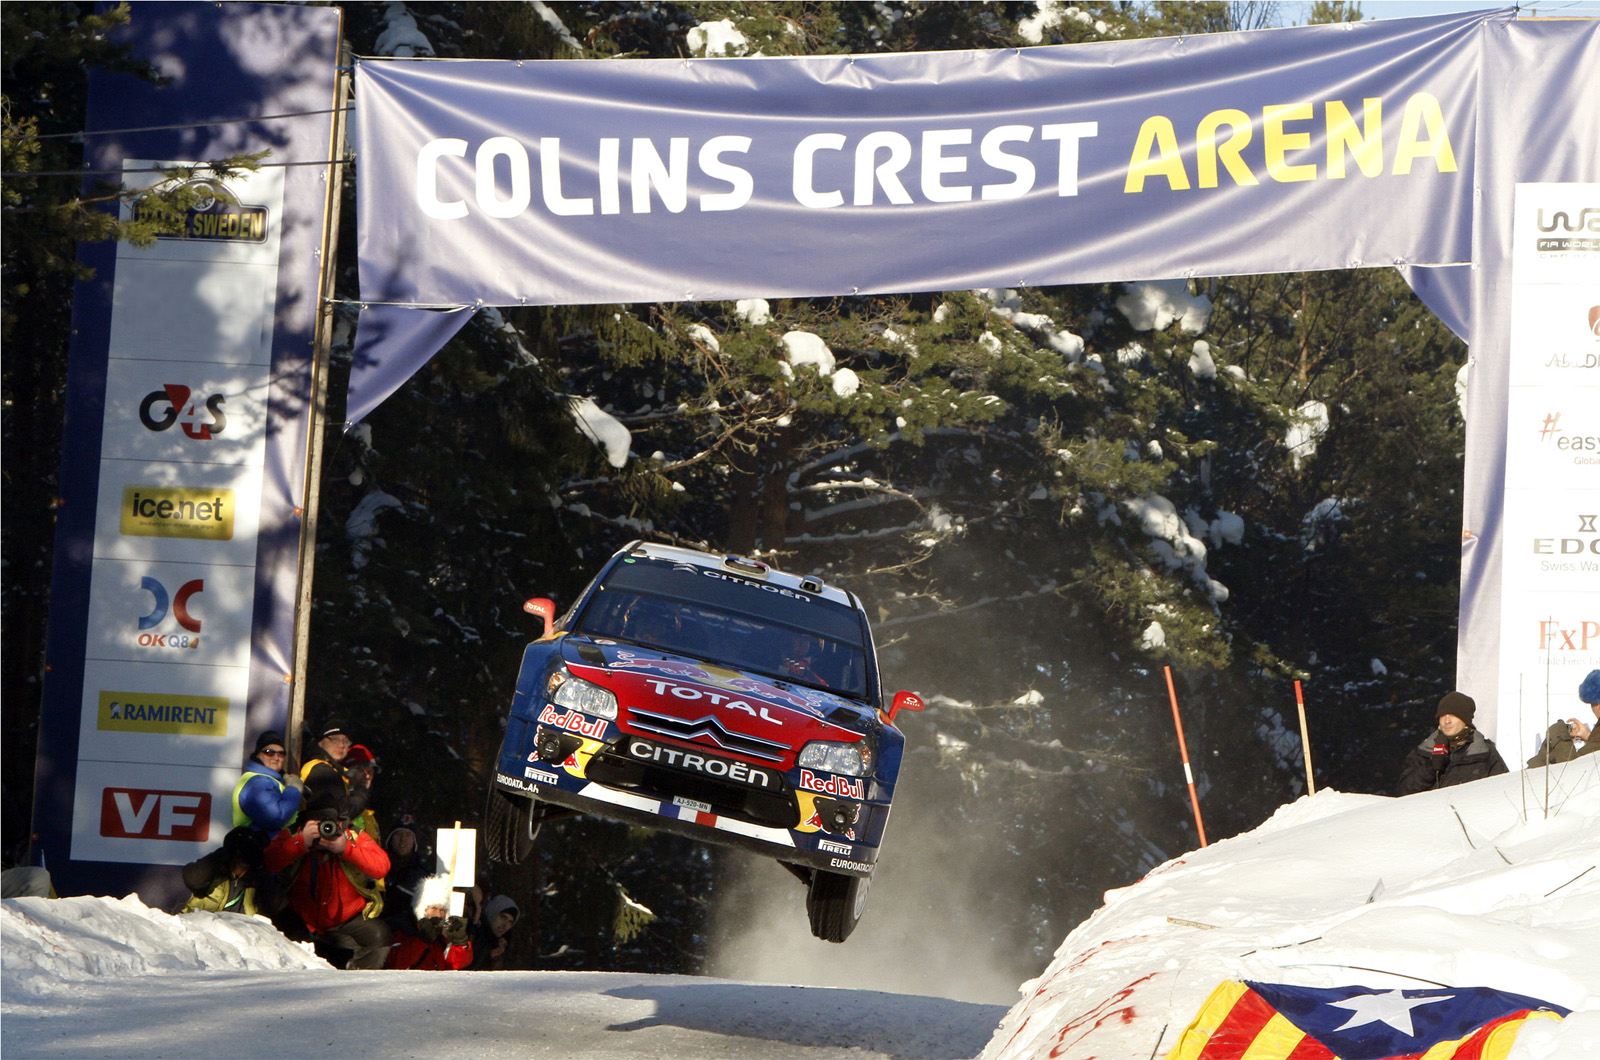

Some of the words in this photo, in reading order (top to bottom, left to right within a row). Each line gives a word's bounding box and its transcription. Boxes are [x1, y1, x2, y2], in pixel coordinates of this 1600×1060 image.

[417, 135, 754, 220] COLINS
[792, 121, 1098, 209] CREST
[1124, 91, 1458, 193] ARENA
[193, 212, 263, 238] SWEDEN
[139, 383, 227, 440] G4S
[132, 492, 223, 522] ice.net
[1540, 560, 1576, 571] Swiss
[1579, 560, 1600, 571] Wa
[526, 602, 546, 614] TOTAL
[123, 703, 218, 725] RAMIRENT
[645, 679, 783, 725] TOTAL
[537, 703, 575, 730] Red
[564, 711, 609, 740] Bull
[524, 766, 559, 786] PIRELLI
[800, 769, 838, 796] Red
[837, 776, 865, 800] Bull
[113, 792, 202, 836] VF
[818, 839, 852, 855] PIRELLI
